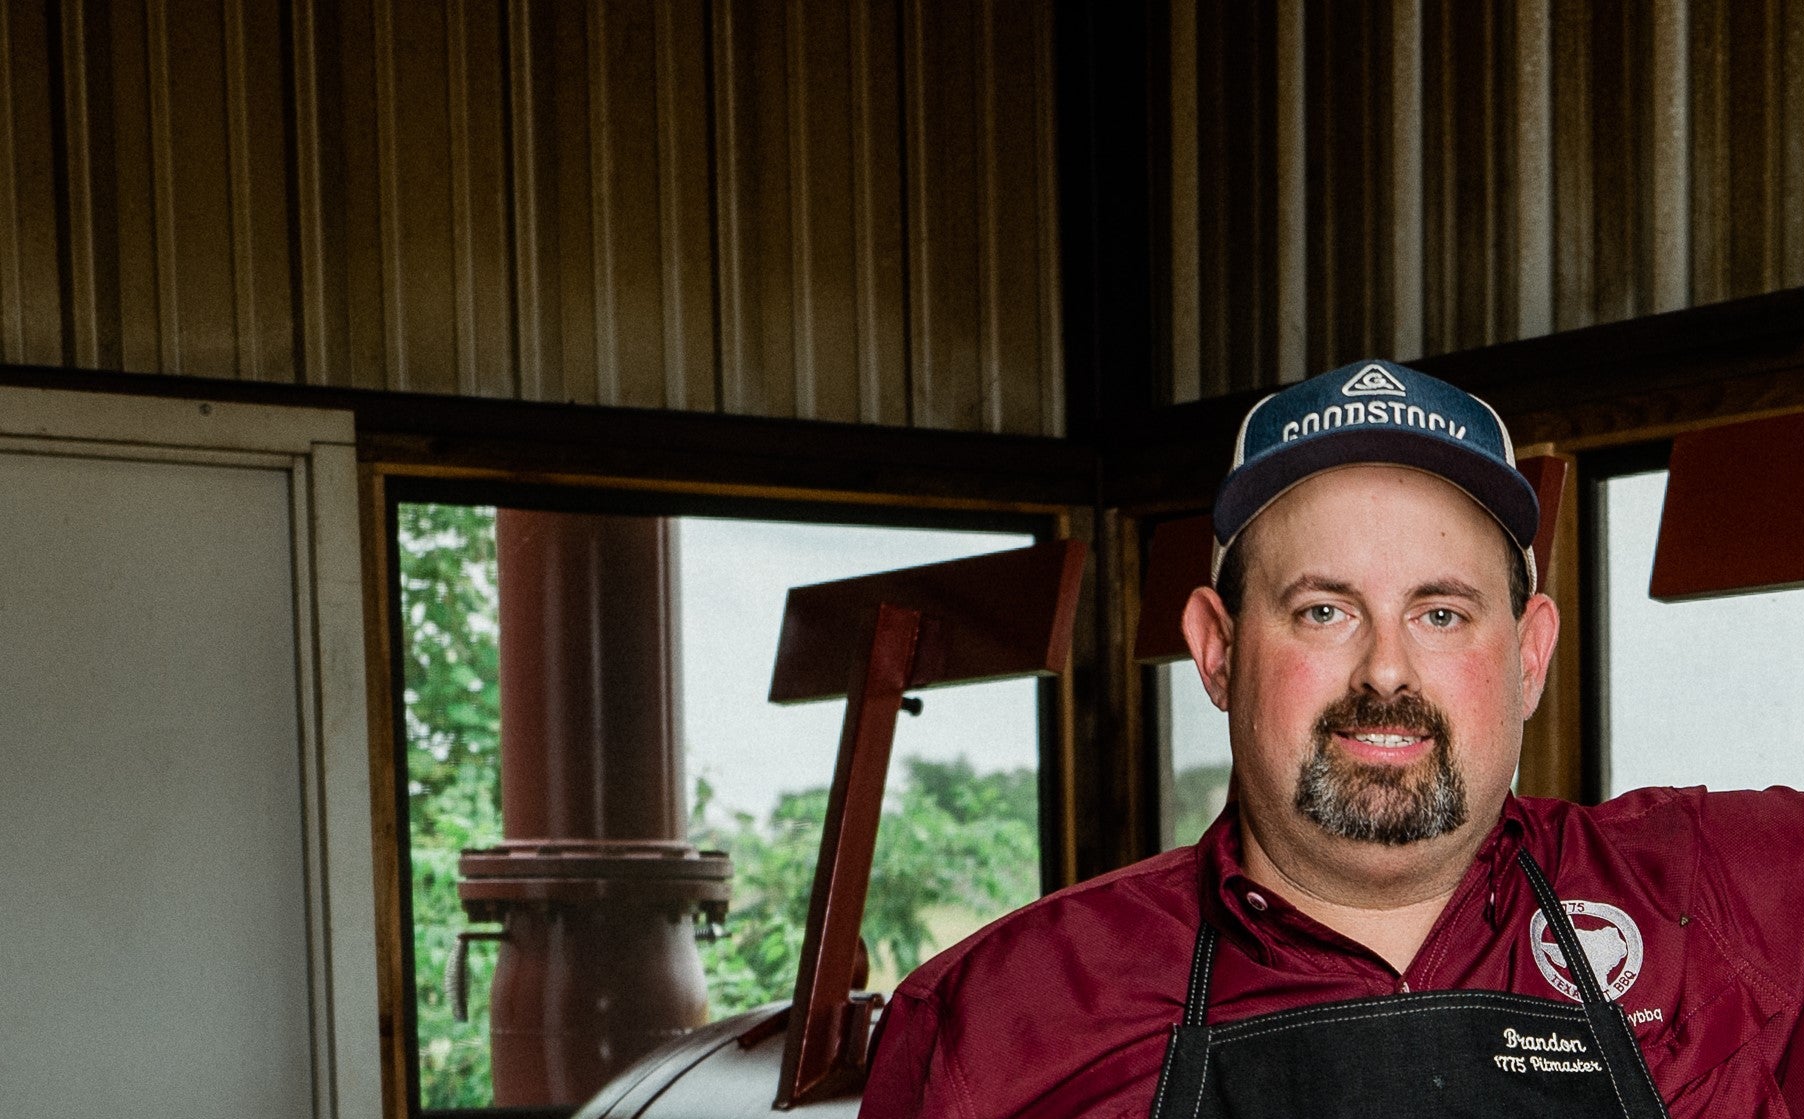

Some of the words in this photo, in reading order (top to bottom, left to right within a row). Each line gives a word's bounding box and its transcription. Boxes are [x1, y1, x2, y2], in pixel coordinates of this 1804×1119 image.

[1551, 974, 1581, 1000] TEXA
[1613, 970, 1636, 993] BBQ
[1503, 1028, 1587, 1053] Brandon
[1493, 1055, 1527, 1074] 1775
[1530, 1056, 1603, 1073] Pitmaster
